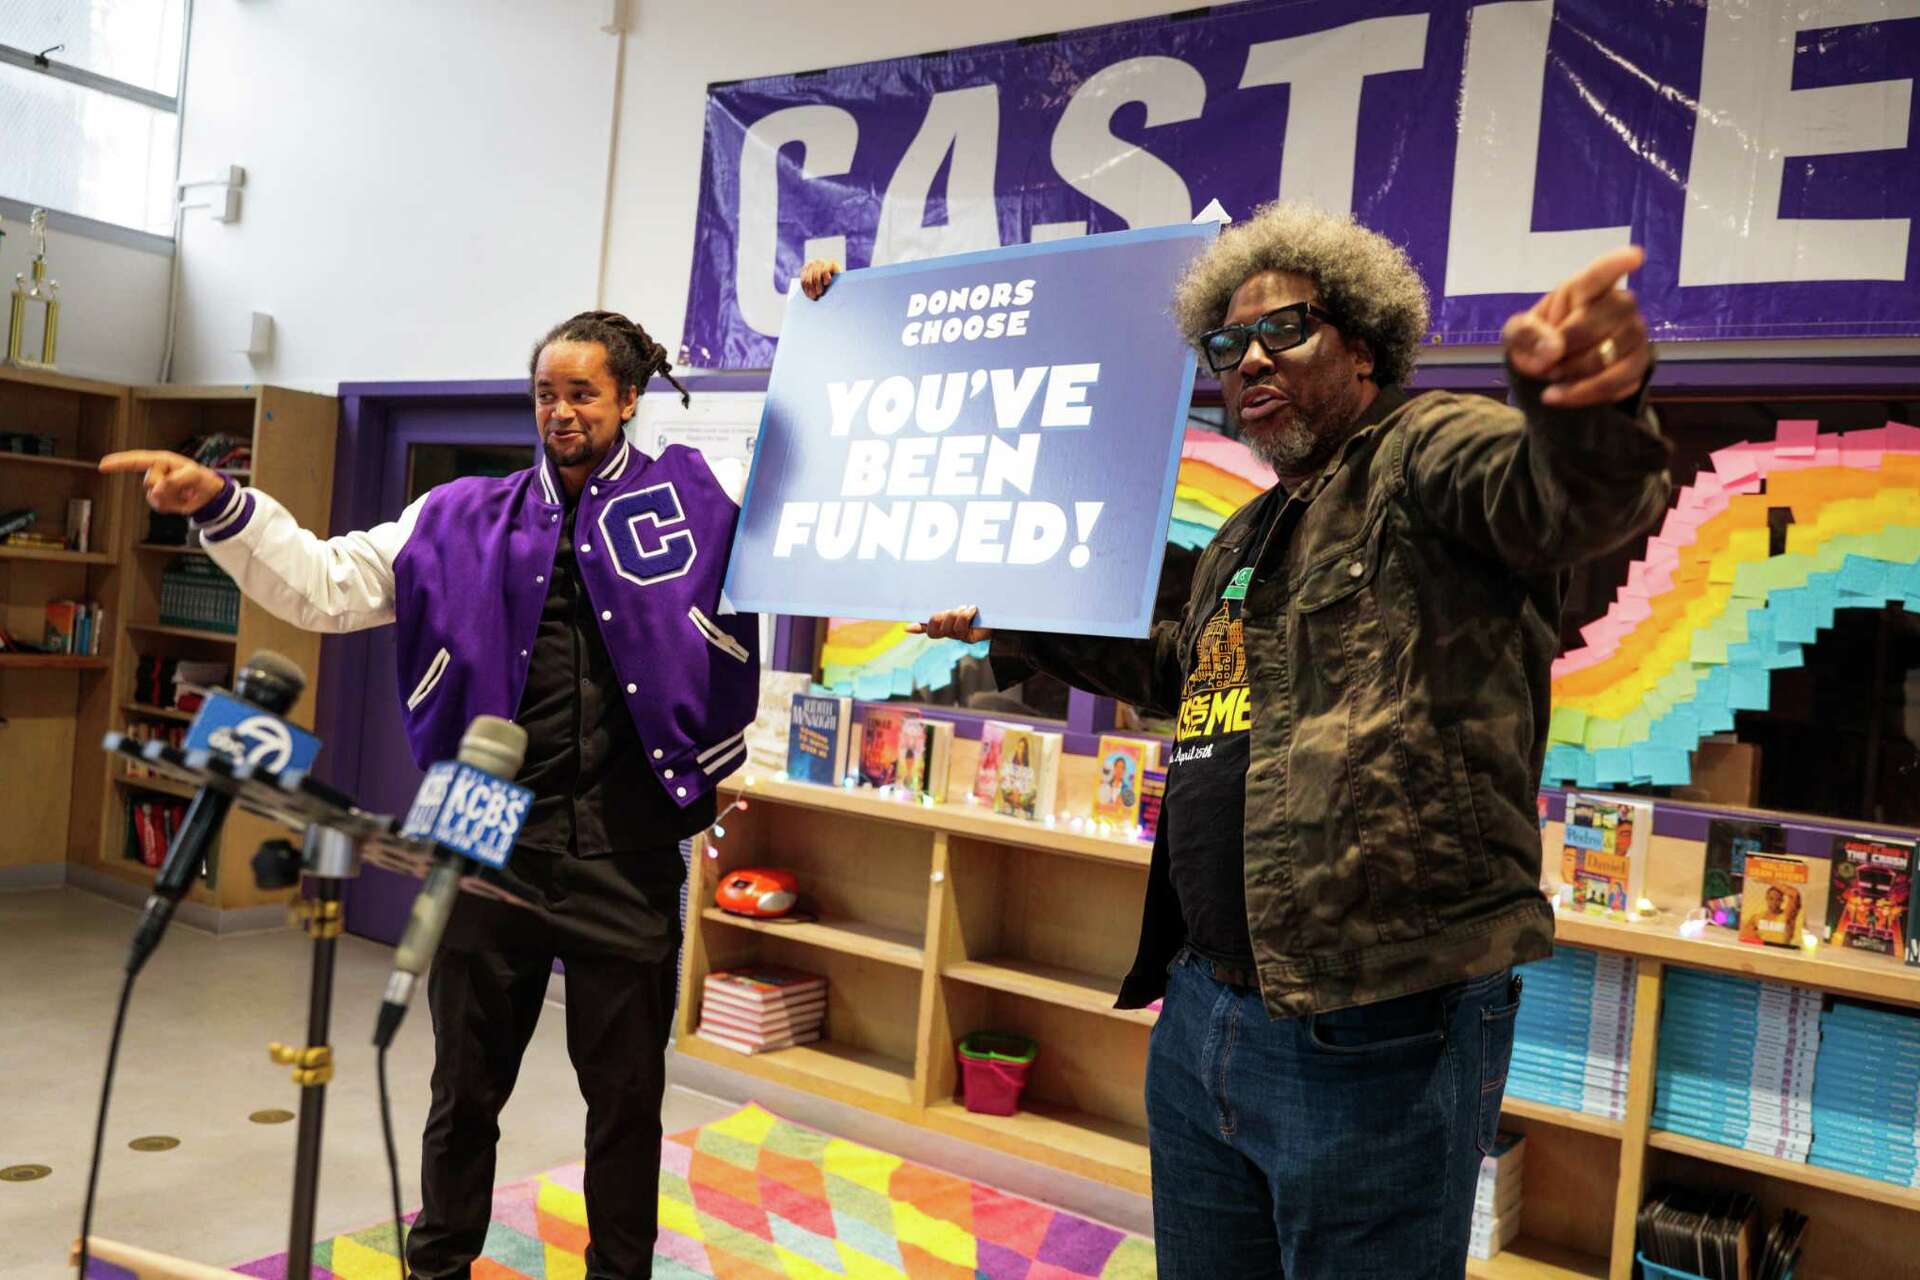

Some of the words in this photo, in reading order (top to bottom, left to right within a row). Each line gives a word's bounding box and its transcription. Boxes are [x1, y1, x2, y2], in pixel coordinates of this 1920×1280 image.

[734, 0, 1920, 338] CASTLE
[901, 310, 1029, 347] CHOOSE
[906, 279, 1036, 318] DONORS
[826, 362, 1101, 437] YOU'VE
[840, 432, 1041, 498] BEEN
[597, 481, 699, 587] C
[773, 500, 1105, 570] FUNDED!
[1174, 746, 1195, 767] April
[444, 775, 526, 836] KCBS
[1567, 828, 1602, 847] Pedro
[1586, 855, 1627, 874] Daniel
